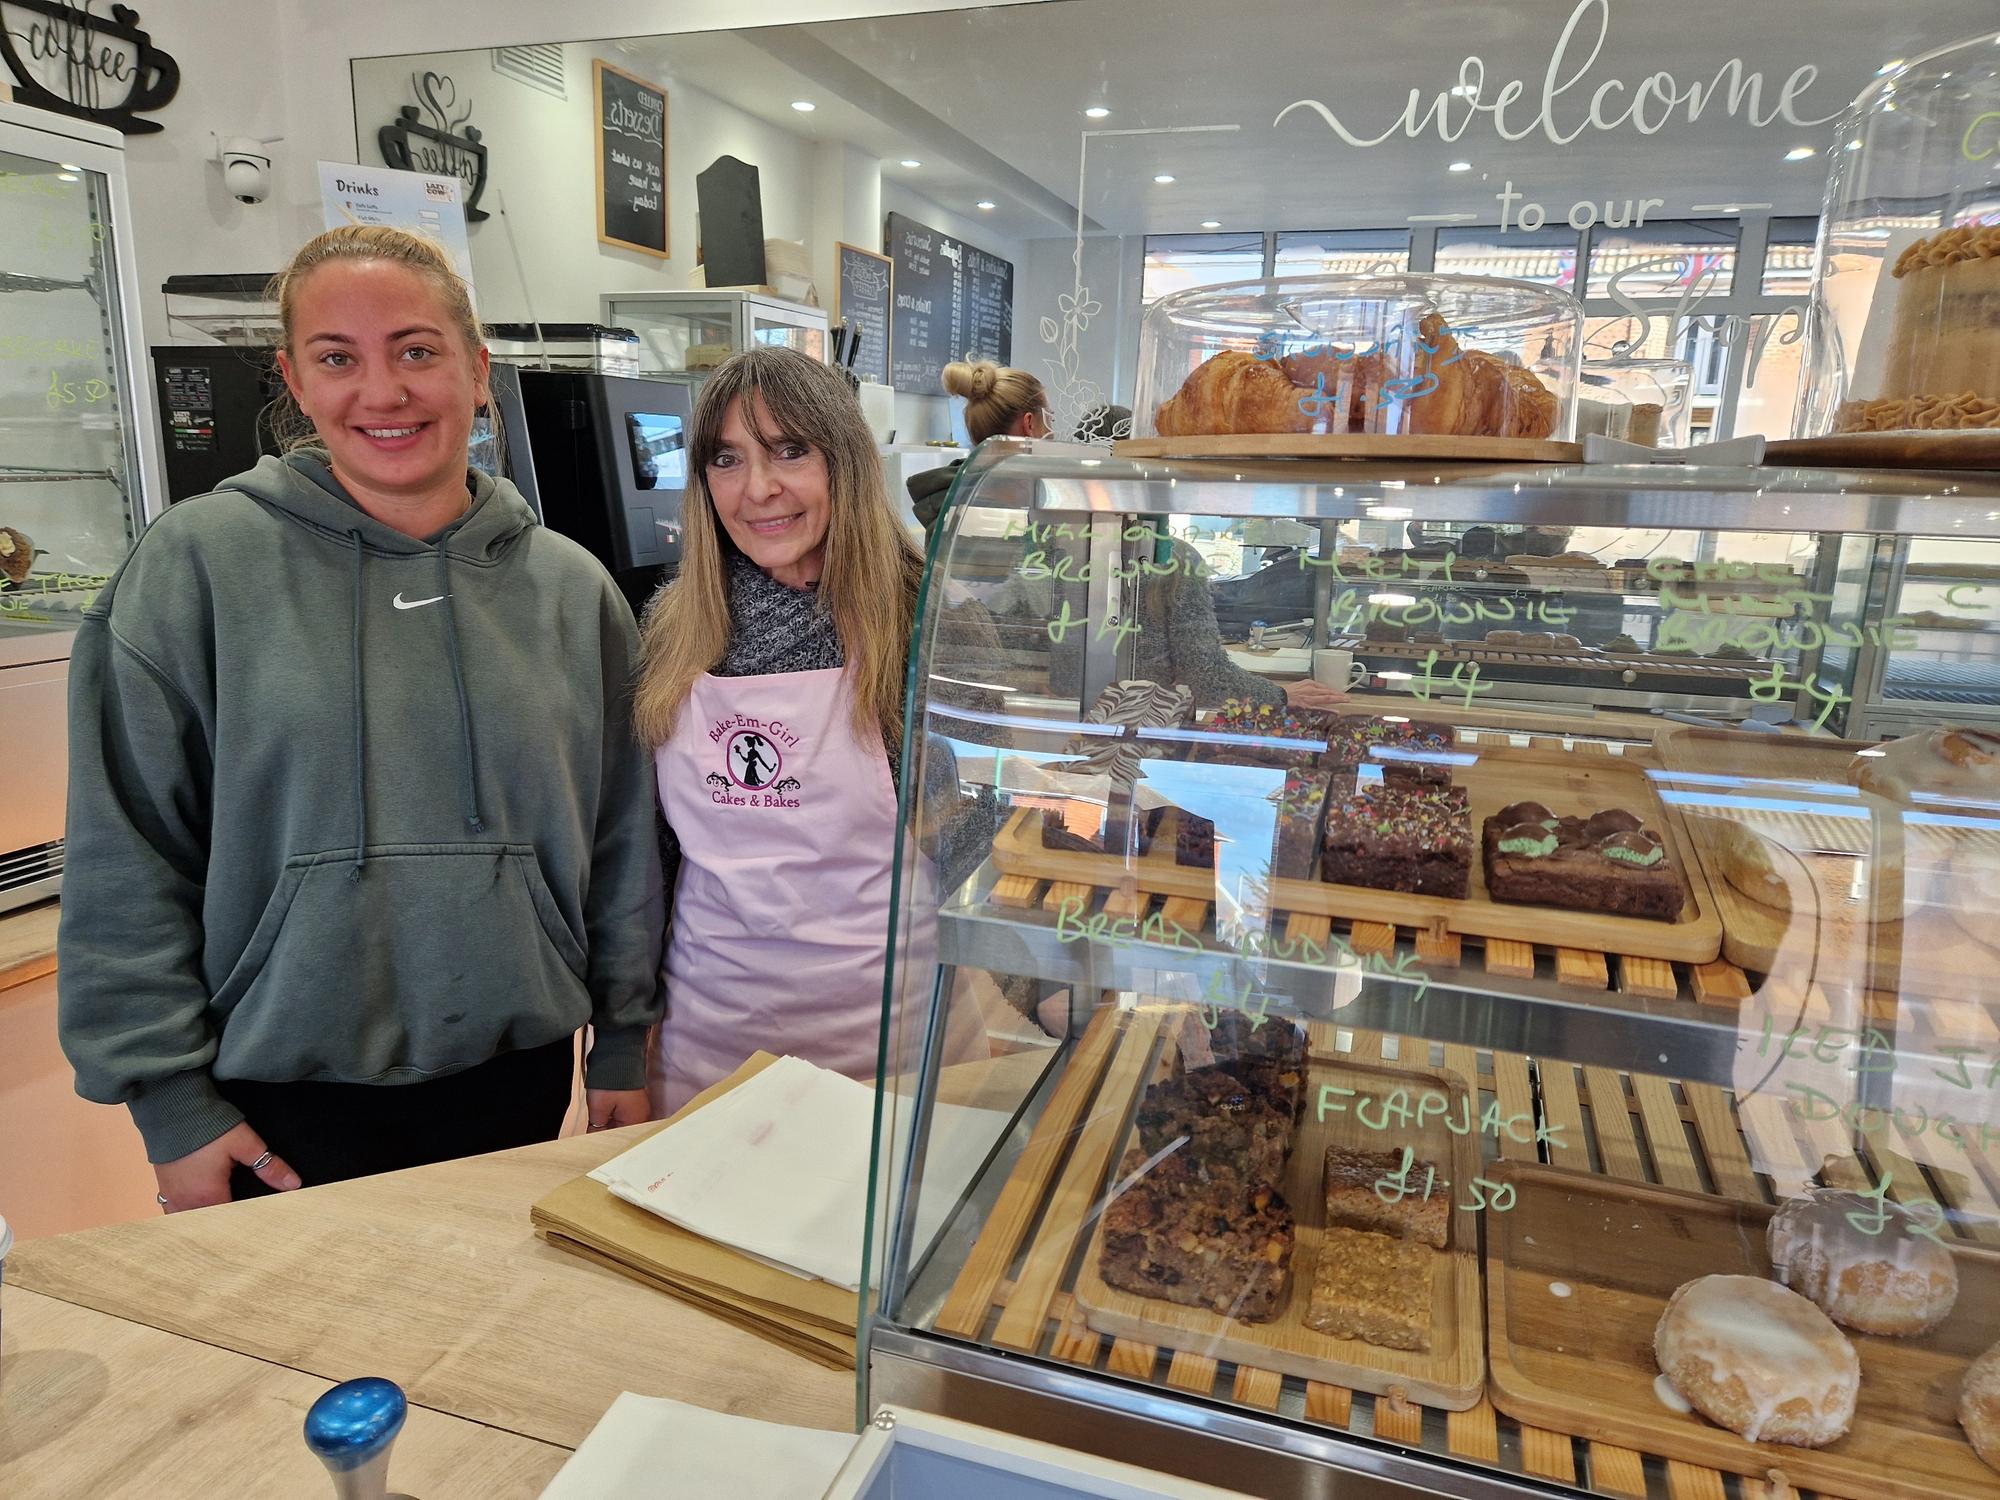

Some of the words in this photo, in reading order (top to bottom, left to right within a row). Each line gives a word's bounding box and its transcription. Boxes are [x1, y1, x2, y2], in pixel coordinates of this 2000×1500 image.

[30, 8, 137, 114] coffee
[1273, 0, 1860, 147] welcome
[336, 179, 379, 197] Drinks
[426, 182, 444, 191] LAZY
[1496, 181, 1545, 233] to
[1568, 197, 1663, 230] our
[1583, 257, 1806, 390] Shop
[1048, 600, 1142, 656] £4
[1328, 586, 1578, 627] BROWNIE
[1656, 611, 1919, 651] BROWNIE
[1408, 649, 1493, 710] £4
[1749, 663, 1852, 734] £4
[709, 714, 800, 748] Bake-Em-Girl
[712, 791, 747, 806] Cakes
[750, 795, 760, 807] &
[763, 795, 801, 808] Bakes
[1056, 896, 1204, 959] BREAD
[1242, 931, 1430, 1001] PUDDING
[1760, 1014, 1898, 1073] ICED
[1375, 1145, 1517, 1212] £1.50
[1845, 1172, 1950, 1250] £2
